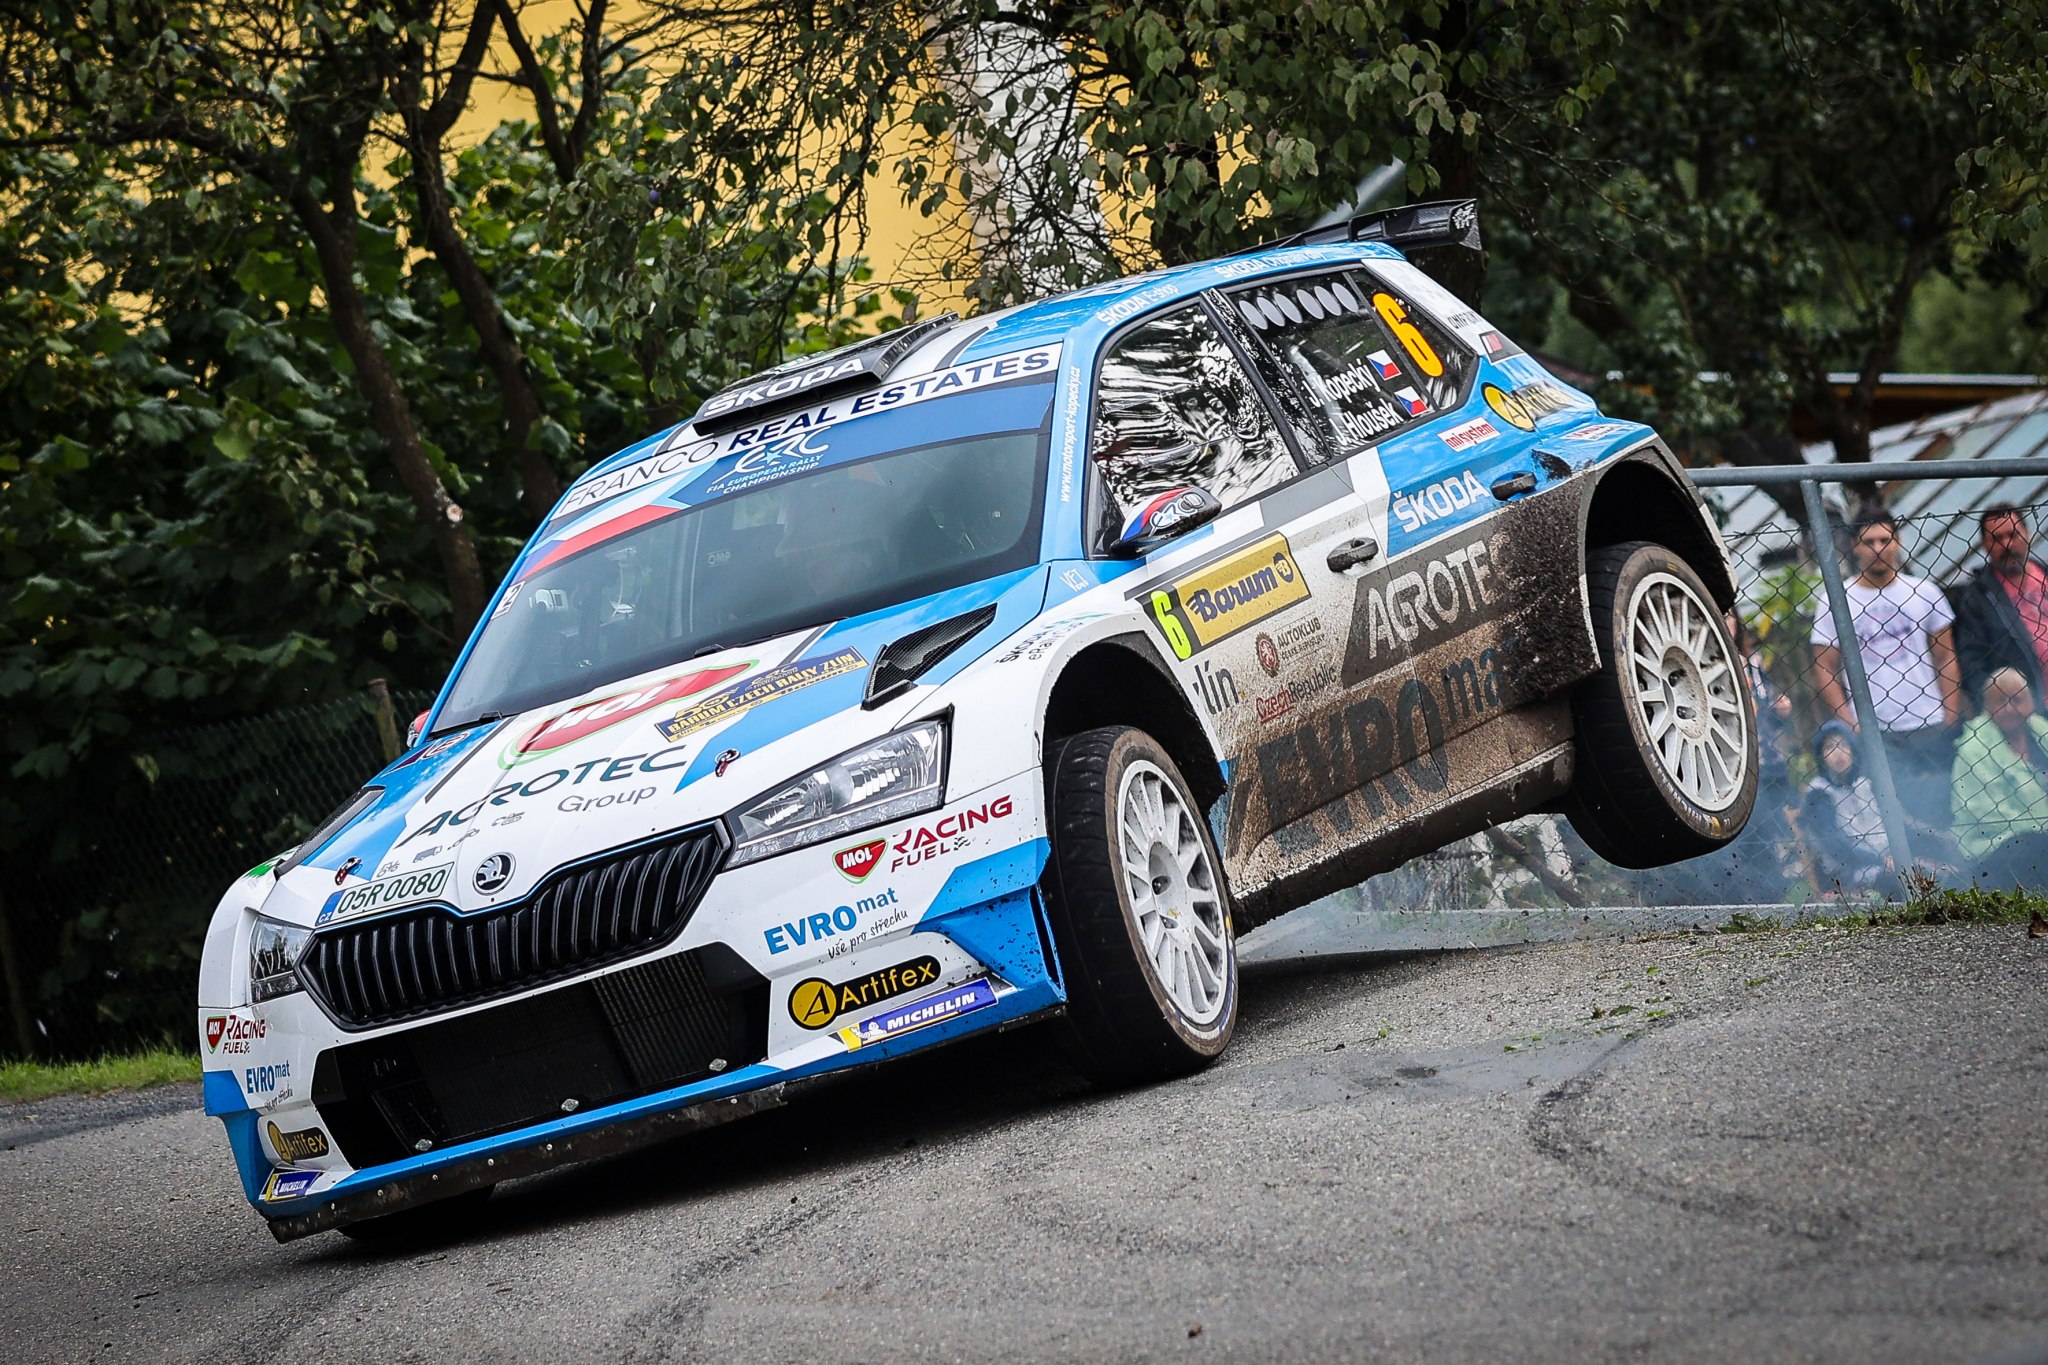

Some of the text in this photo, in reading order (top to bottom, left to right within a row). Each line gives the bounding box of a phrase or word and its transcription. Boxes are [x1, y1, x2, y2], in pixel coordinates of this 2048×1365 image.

[1095, 296, 1150, 327] ŠKODA
[1373, 293, 1444, 377] 6
[1317, 358, 1381, 403] Kopecký
[559, 352, 1050, 514] FRANCO REAL ESTATES
[1339, 398, 1405, 442] Hloušek
[705, 454, 824, 494] FIA EUROPEAN RALLY
[723, 462, 819, 494] CHAMPIONSHIP
[1393, 470, 1491, 533] ŠKODA
[1151, 590, 1192, 660] 6
[1185, 566, 1279, 622] Barum
[1368, 534, 1508, 659] AGROTE
[1276, 617, 1321, 649] AUTOKLUB
[667, 704, 725, 733] BARUM
[726, 684, 775, 708] CZECH
[775, 666, 818, 688] RALLY
[1193, 660, 1239, 714] lín
[393, 744, 688, 849] AGROTEC
[557, 786, 658, 813] Group
[893, 795, 1013, 854] RACING
[843, 847, 873, 870] MOL
[891, 842, 950, 873] FUEL
[318, 910, 332, 924] CZ
[383, 869, 447, 902] 0080
[827, 908, 908, 959] vše pro střechu
[841, 961, 936, 1011] Artifex
[226, 1014, 266, 1040] RACING
[886, 992, 976, 1031] MICHELIN
[222, 1041, 244, 1054] FUEL
[288, 1133, 327, 1157] Artifex
